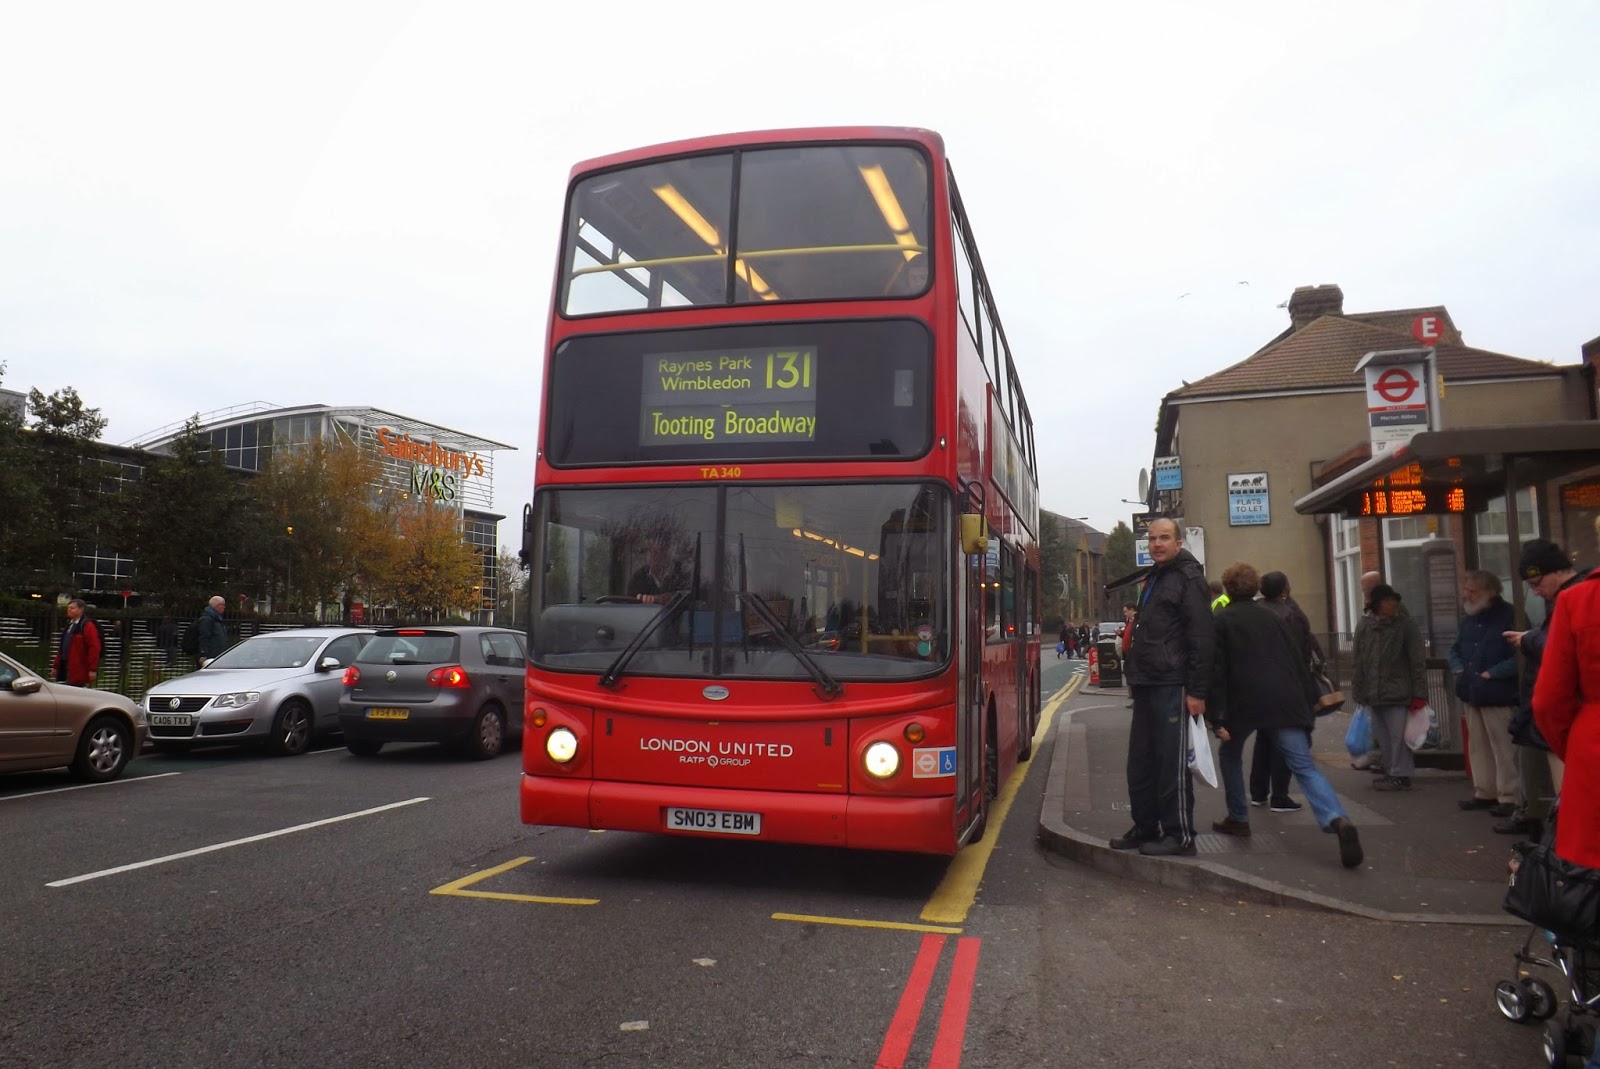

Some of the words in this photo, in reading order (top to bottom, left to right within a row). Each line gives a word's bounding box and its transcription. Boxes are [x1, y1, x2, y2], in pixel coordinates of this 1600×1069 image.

[1422, 317, 1438, 337] E
[658, 359, 713, 376] Raynes
[719, 355, 753, 371] Park
[766, 352, 811, 389] 131
[661, 375, 751, 392] Wimbledon
[652, 412, 716, 440] Tooting
[725, 410, 816, 438] Broadway
[377, 427, 485, 480] Sainsbury's
[410, 462, 456, 502] M&S
[701, 467, 719, 479] TA
[721, 467, 742, 479] 340
[153, 716, 171, 725] CA06
[173, 716, 188, 725] TXX
[640, 737, 711, 753] LONDON
[719, 741, 794, 758] UNITED
[679, 755, 705, 764] RATP
[719, 757, 751, 767] GROUP
[674, 810, 716, 828] SN03
[721, 813, 754, 831] EBM
